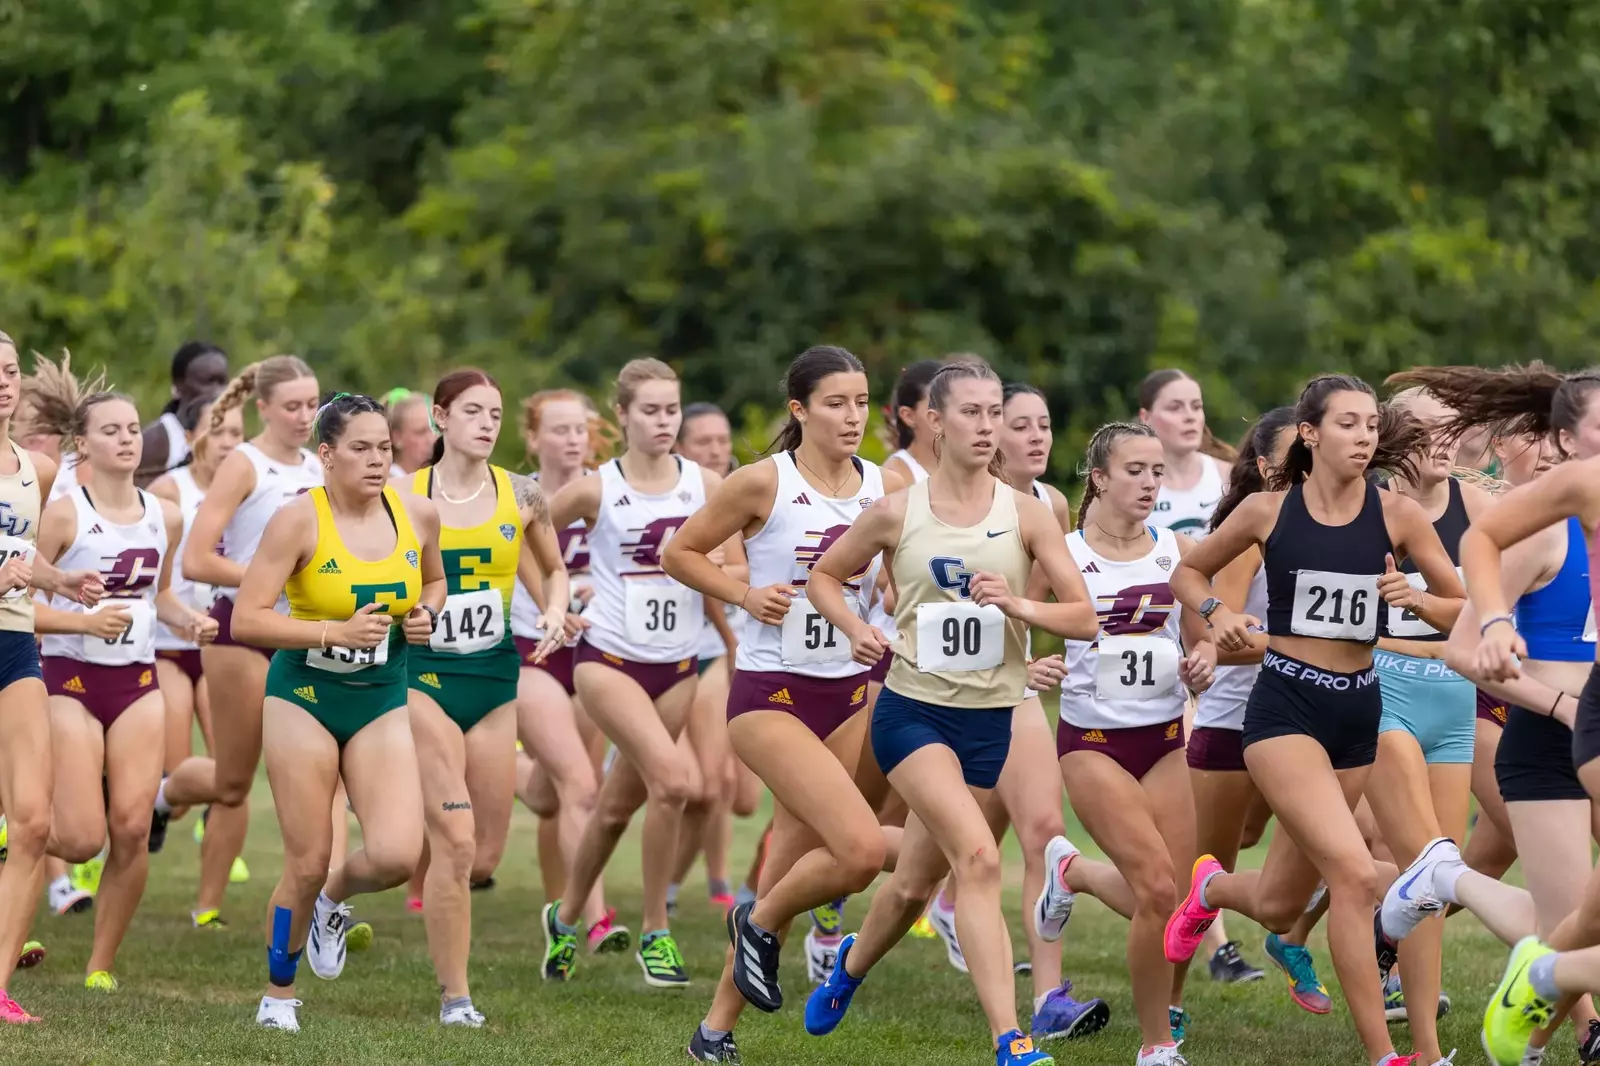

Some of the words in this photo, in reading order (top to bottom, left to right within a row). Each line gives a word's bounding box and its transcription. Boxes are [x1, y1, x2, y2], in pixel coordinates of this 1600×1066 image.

[317, 567, 342, 575] adidas
[441, 548, 492, 596] E
[645, 599, 677, 632] 36
[1306, 586, 1368, 626] 216
[104, 617, 134, 645] 2
[441, 604, 495, 643] 142
[805, 613, 837, 650] 51
[942, 616, 982, 657] 90
[1120, 649, 1156, 686] 31
[1299, 667, 1350, 691] PRO
[1423, 663, 1461, 678] PR
[768, 696, 794, 706] adidas
[1081, 735, 1107, 744] adidas
